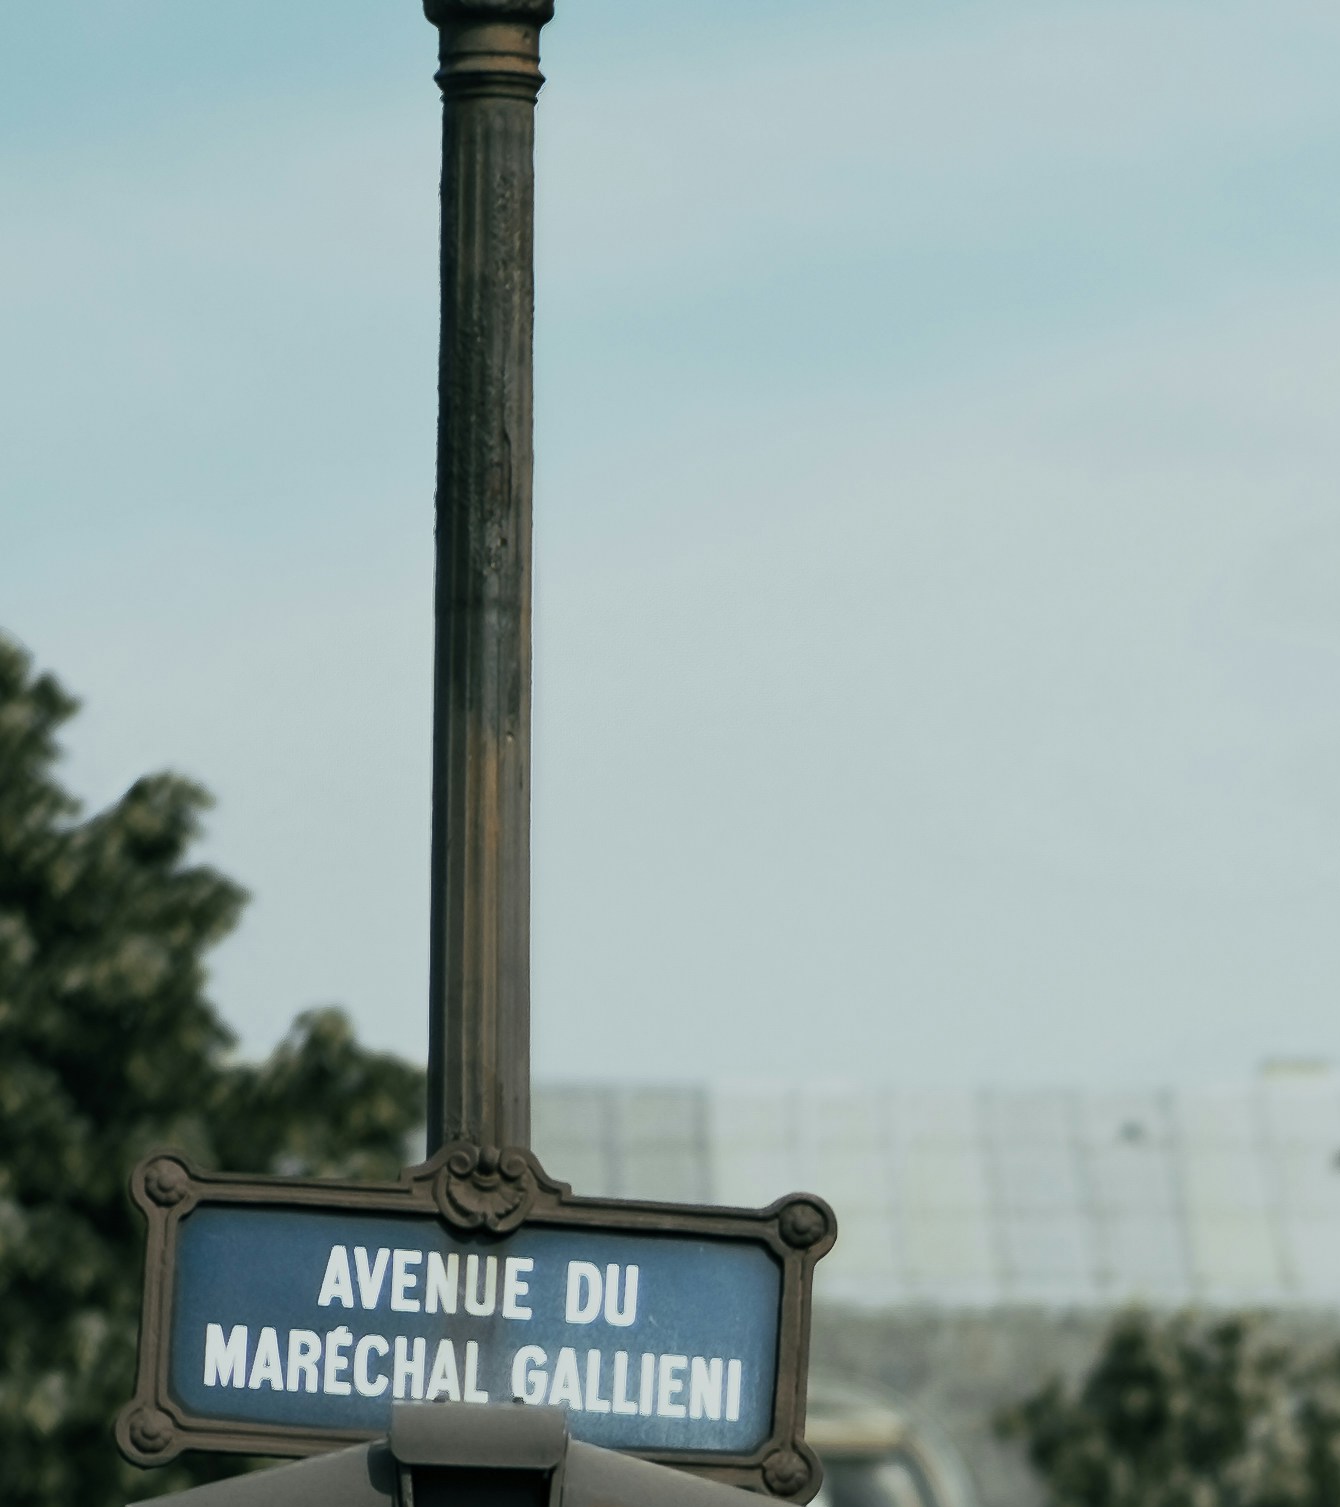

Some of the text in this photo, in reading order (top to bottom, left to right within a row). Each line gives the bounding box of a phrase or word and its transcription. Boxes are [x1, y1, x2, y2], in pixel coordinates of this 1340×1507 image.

[316, 1243, 640, 1328] AVENUE DU
[203, 1322, 743, 1423] MARÉCHAL GALLIENI
